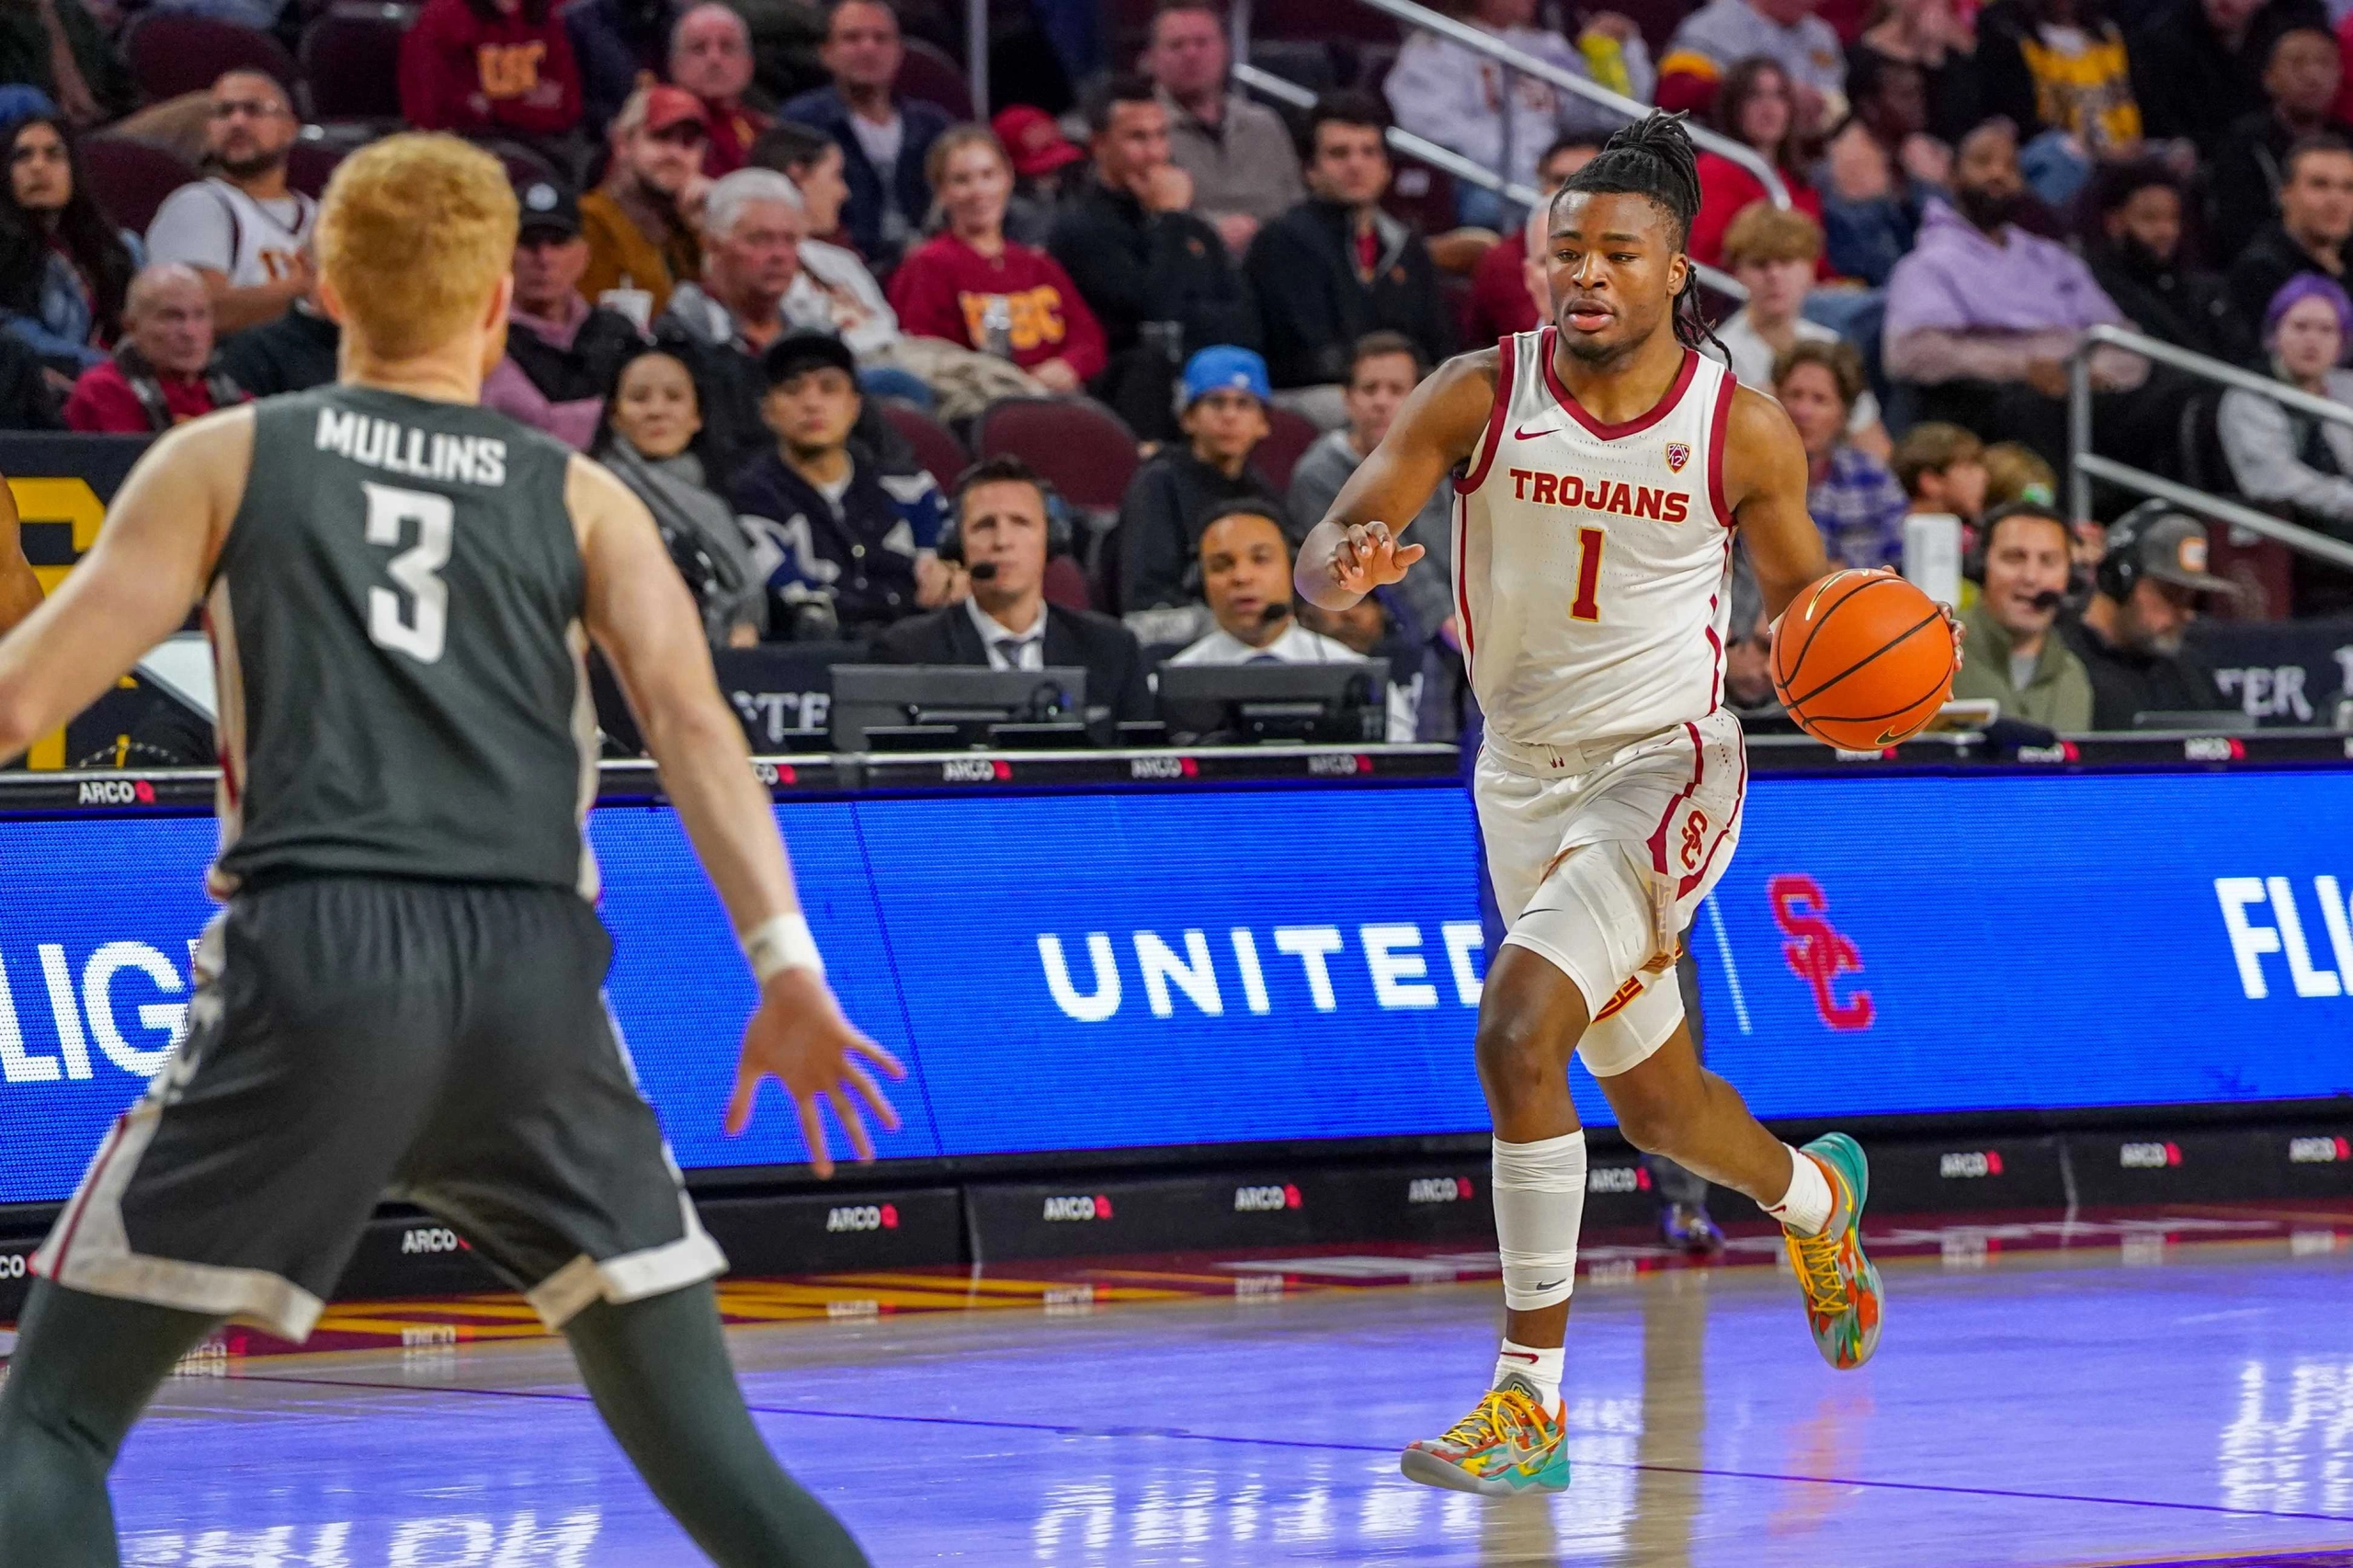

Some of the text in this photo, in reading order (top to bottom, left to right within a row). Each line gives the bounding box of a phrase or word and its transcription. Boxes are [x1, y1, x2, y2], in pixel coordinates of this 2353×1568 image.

[315, 407, 507, 487] MULLINS
[1671, 455, 1683, 467] 12
[1508, 468, 1690, 524] TROJANS
[361, 481, 454, 665] 3
[1569, 528, 1605, 623] 1
[754, 764, 779, 785] CO
[79, 781, 135, 804] ARCO
[2213, 875, 2353, 1000] FLI
[0, 939, 199, 1083] LIG
[1588, 1167, 1637, 1193] ARCO
[1043, 1196, 1096, 1221] ARCO
[1234, 1185, 1285, 1211] ARCO
[827, 1205, 881, 1232] ARCO
[402, 1227, 458, 1254] ARCO
[0, 1255, 26, 1278] CO
